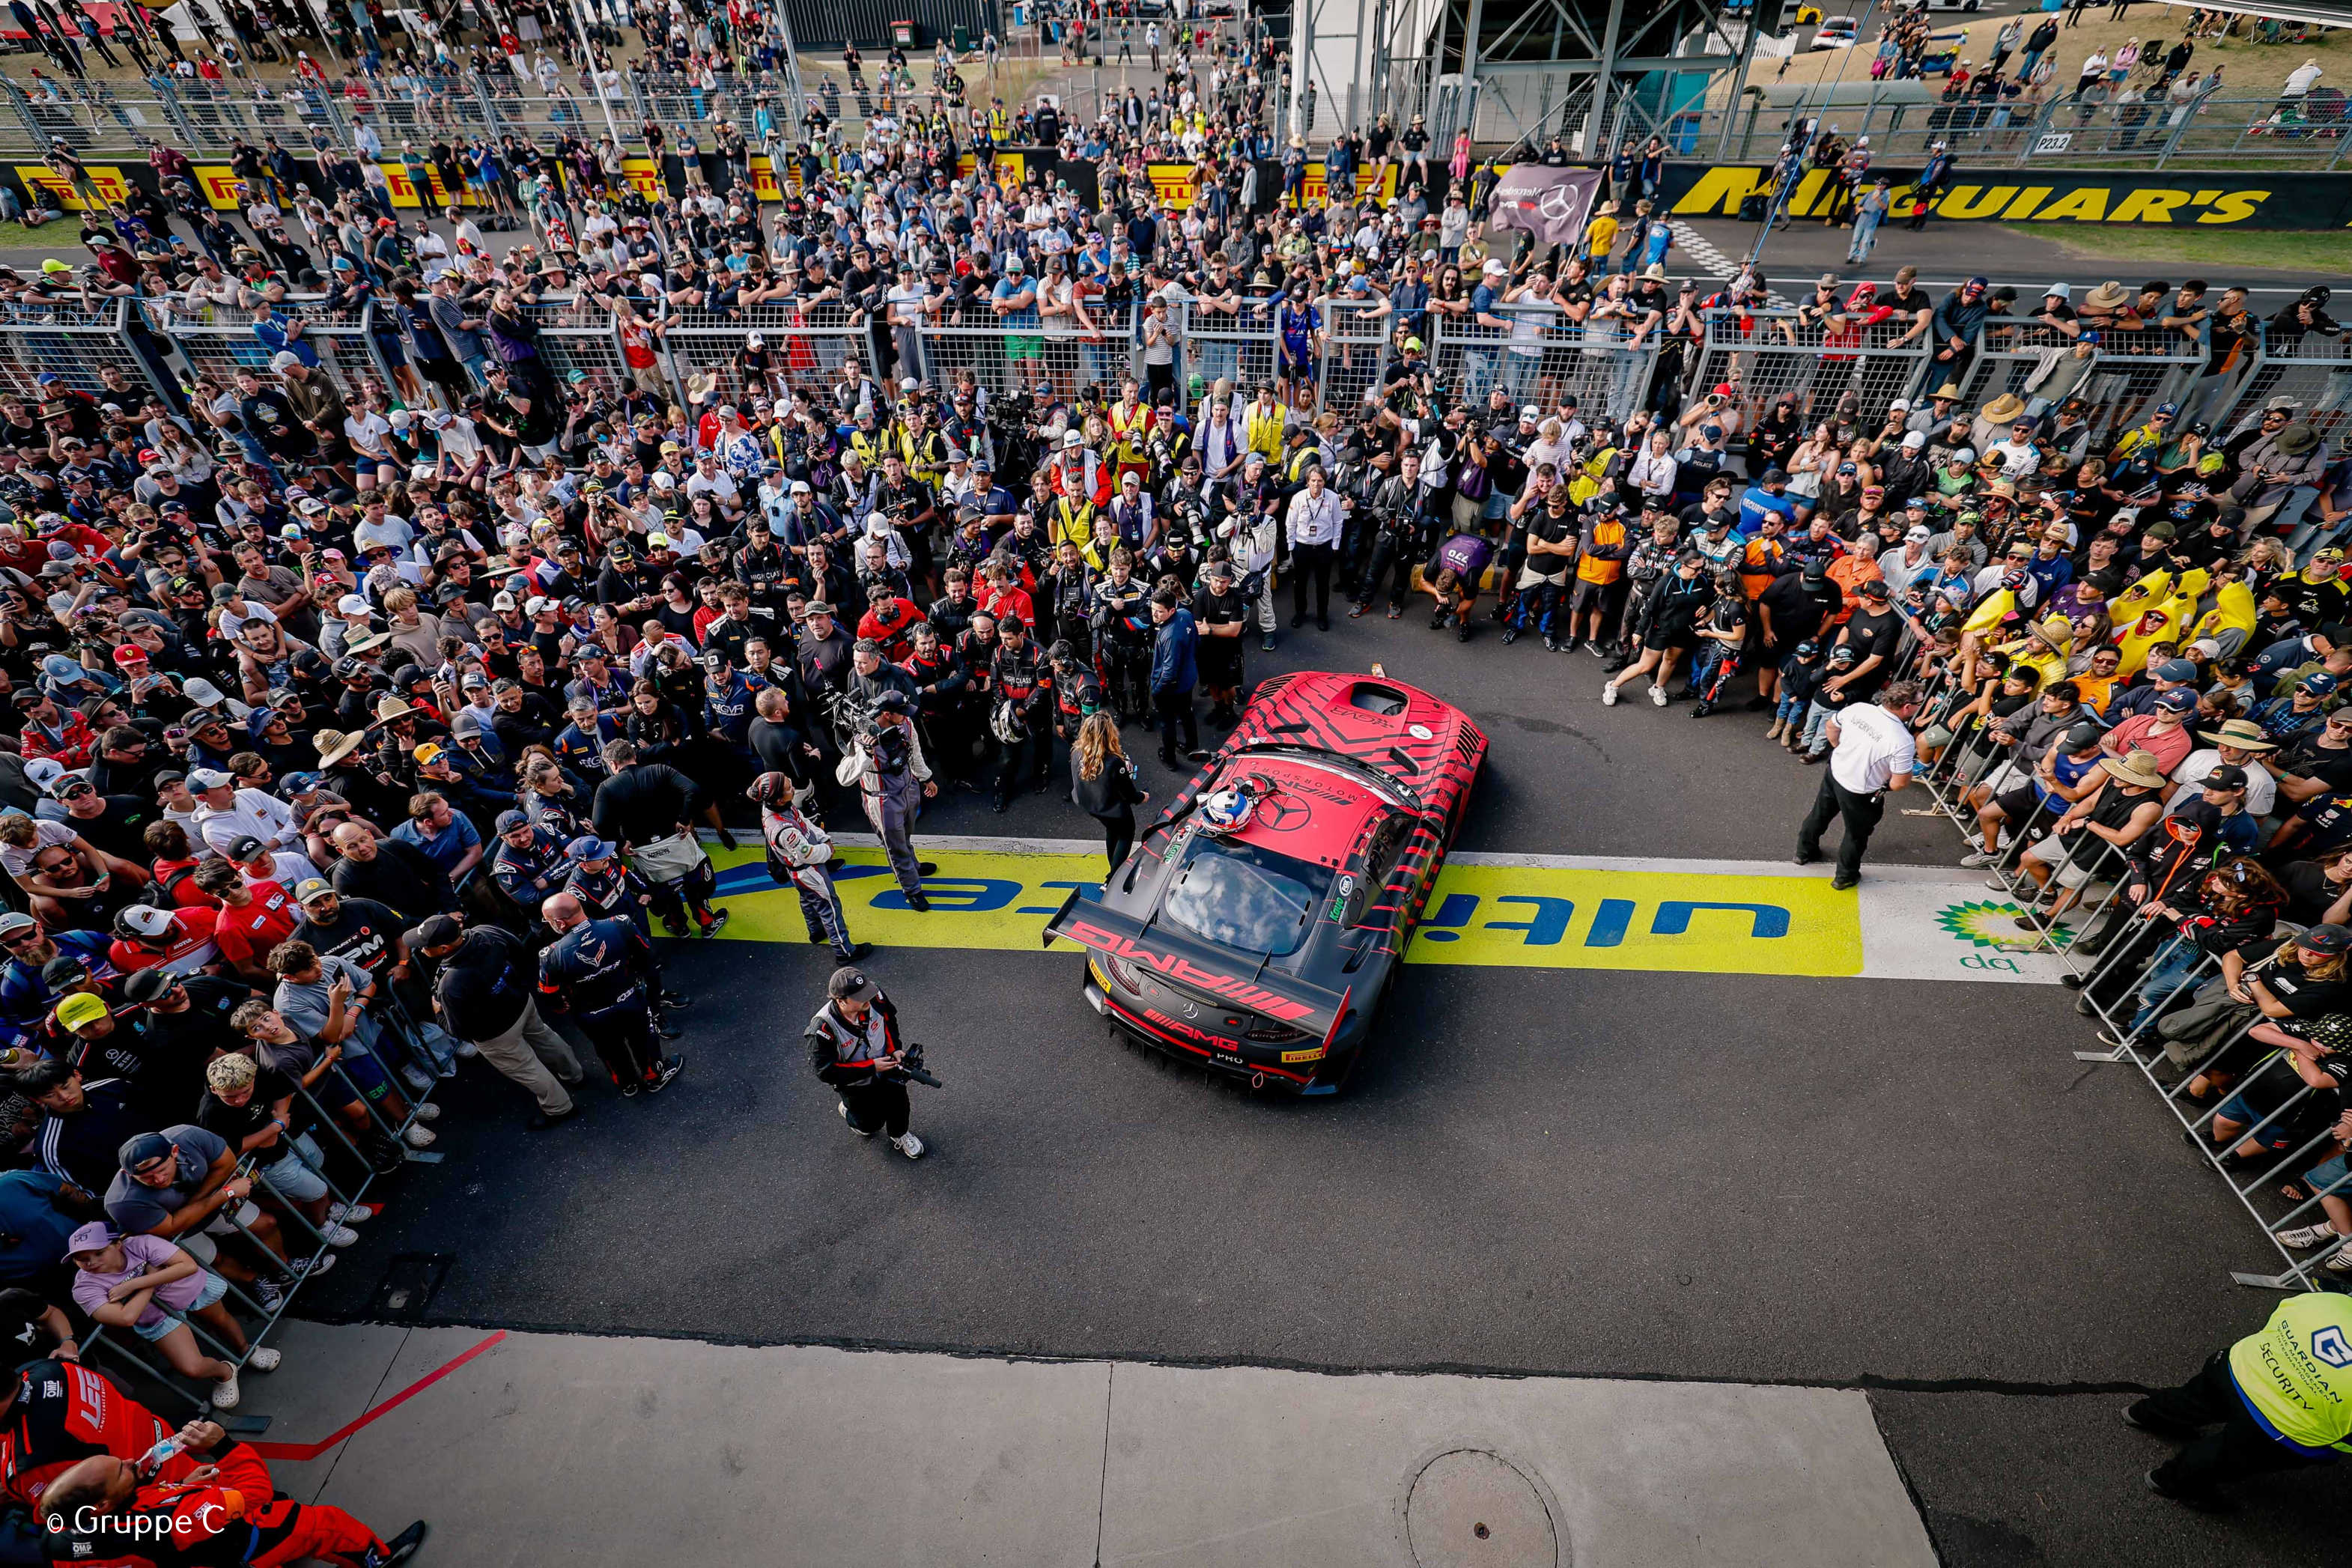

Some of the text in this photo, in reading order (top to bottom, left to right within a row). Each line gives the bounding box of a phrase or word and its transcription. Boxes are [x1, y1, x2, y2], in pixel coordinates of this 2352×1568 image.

[2038, 137, 2068, 150] P23.2
[1693, 460, 1713, 469] POLICE
[1742, 497, 1771, 515] SECURITY
[1850, 716, 1883, 743] SUPERVISOR
[1251, 765, 1358, 802] MOTORSPORT
[1330, 896, 1345, 922] Kayo
[174, 938, 193, 950] MOTUL
[1960, 954, 2022, 973] bp
[2281, 1319, 2343, 1404] GUARDIAN
[2260, 1341, 2315, 1411] SECURITY
[46, 1380, 56, 1397] OMP
[73, 1544, 92, 1553] OMP
